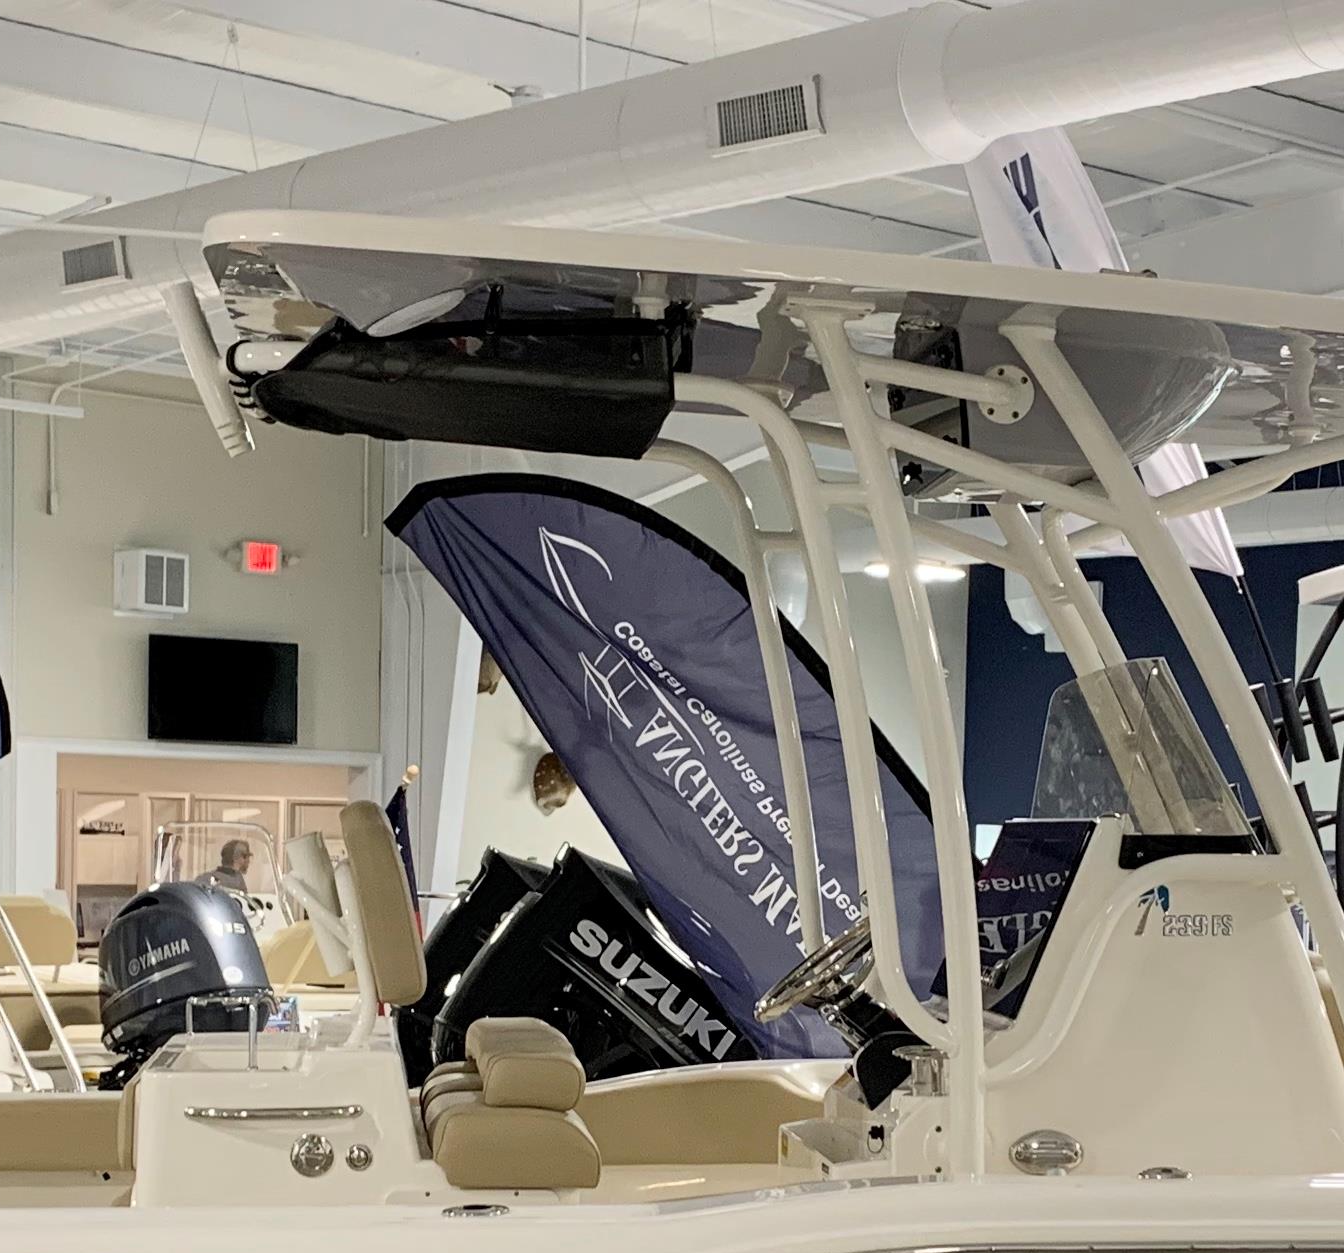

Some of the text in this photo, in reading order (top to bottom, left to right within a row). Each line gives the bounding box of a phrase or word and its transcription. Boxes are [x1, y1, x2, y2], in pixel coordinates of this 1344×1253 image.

[1162, 914, 1233, 936] 239 FS
[139, 937, 191, 970] YAMAHA
[569, 919, 737, 1061] SUZUKI
